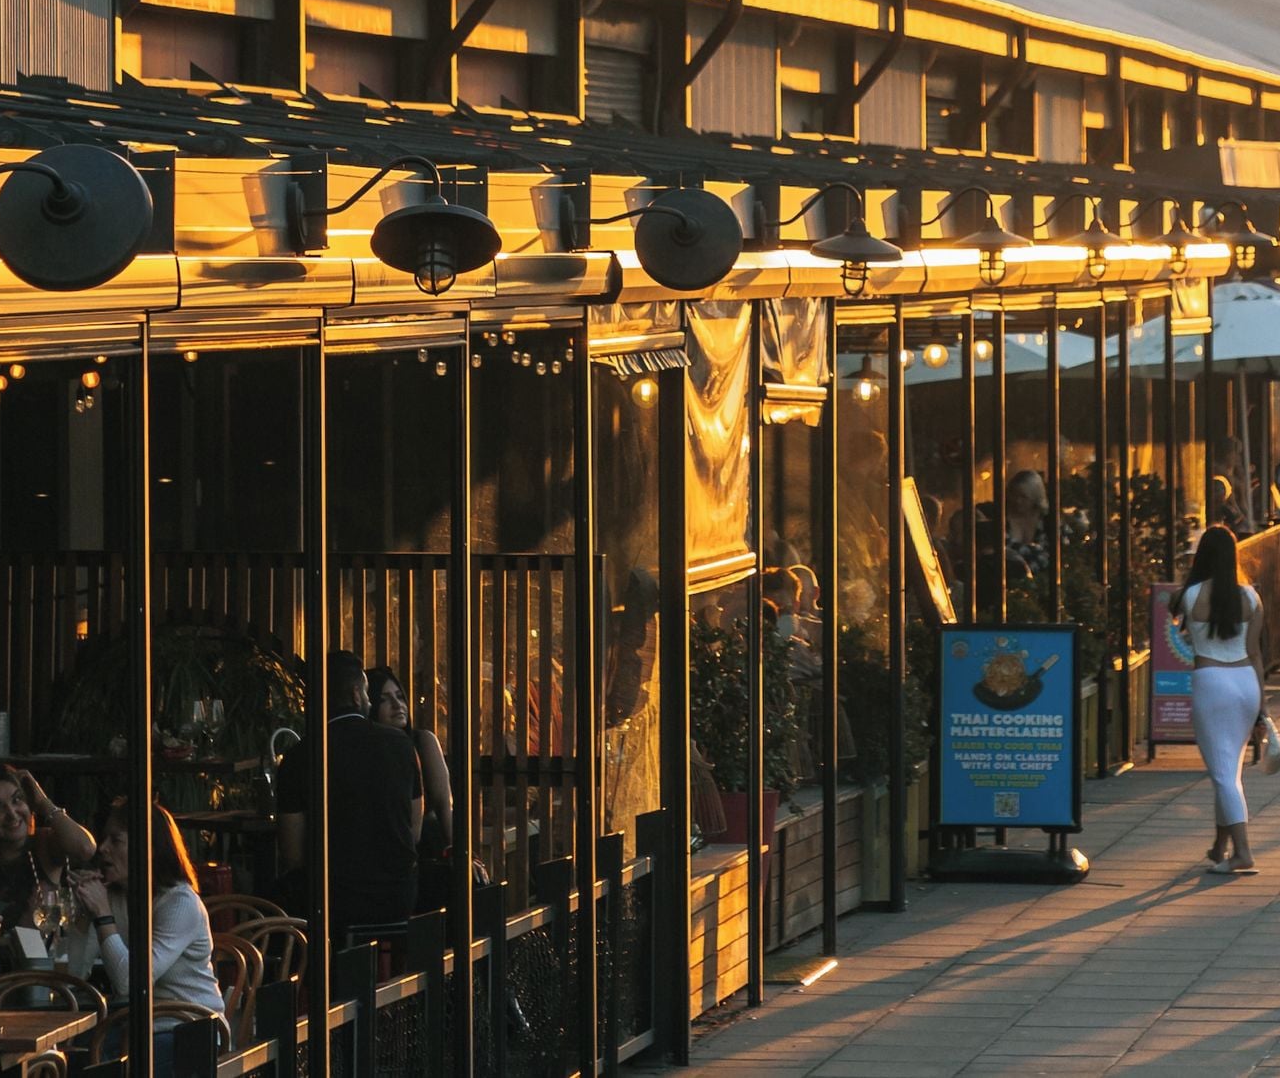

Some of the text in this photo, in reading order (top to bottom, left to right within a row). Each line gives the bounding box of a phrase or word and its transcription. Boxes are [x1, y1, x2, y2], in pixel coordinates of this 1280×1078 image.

[951, 714, 1063, 725] THAI COOKING
[951, 726, 1063, 737] MASTERCLASSES
[954, 753, 993, 761] HANDS
[1015, 754, 1060, 762] CLASSES
[961, 762, 1053, 771] WITH OUR CHEFS
